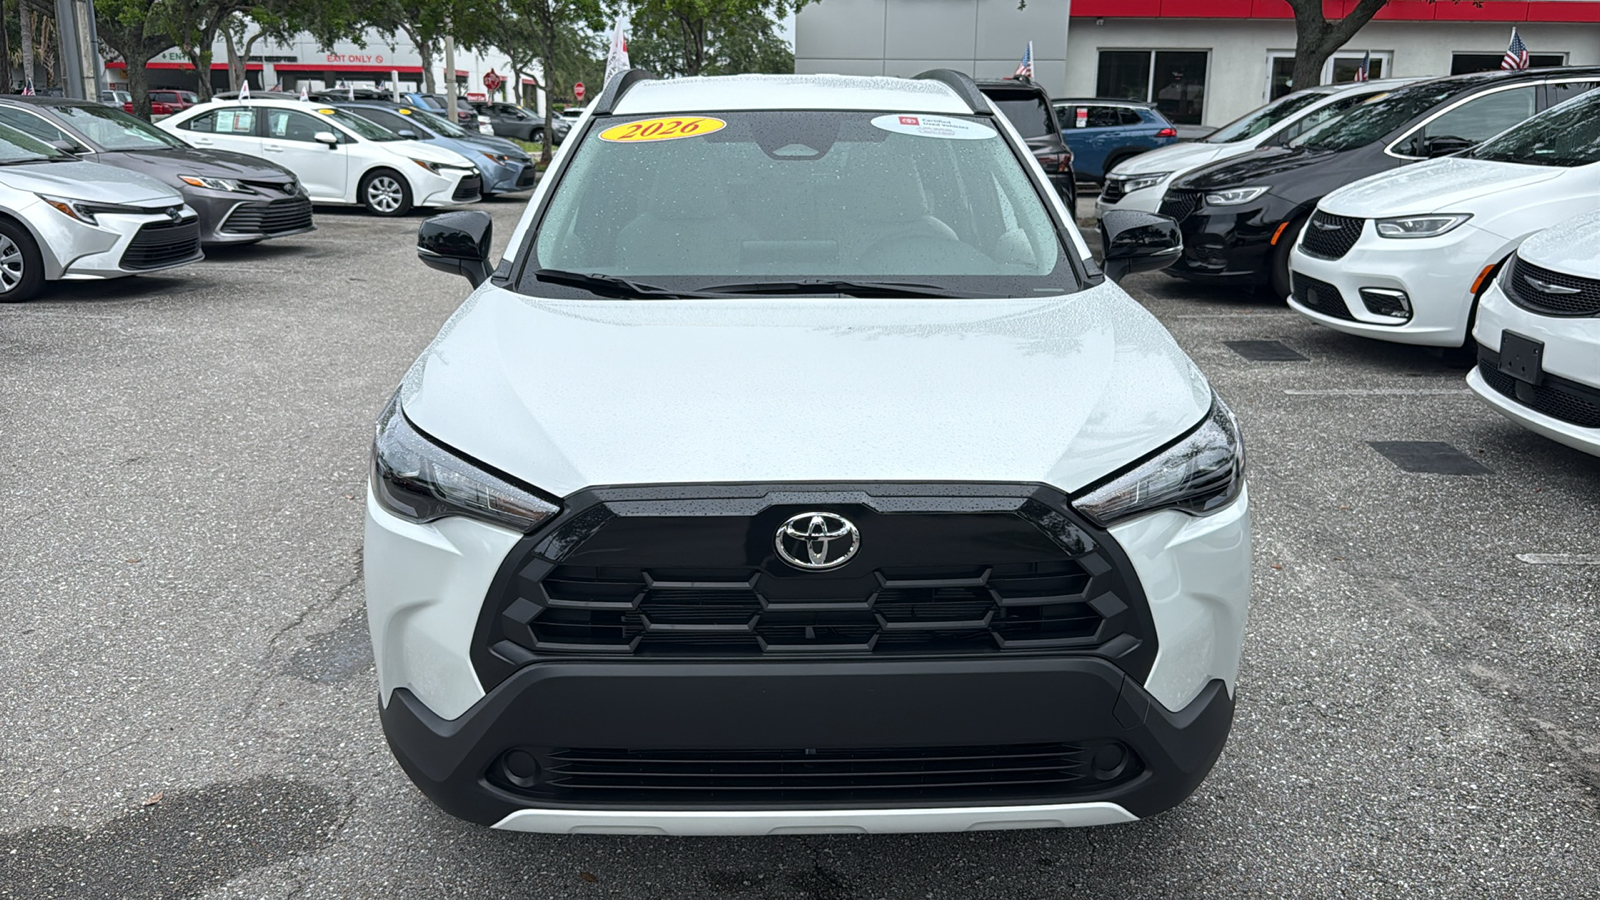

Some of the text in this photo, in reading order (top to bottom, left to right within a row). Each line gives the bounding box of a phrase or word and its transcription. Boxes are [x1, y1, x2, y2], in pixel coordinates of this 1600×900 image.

[327, 54, 372, 63] EXIT ONLY
[617, 118, 706, 140] 2026
